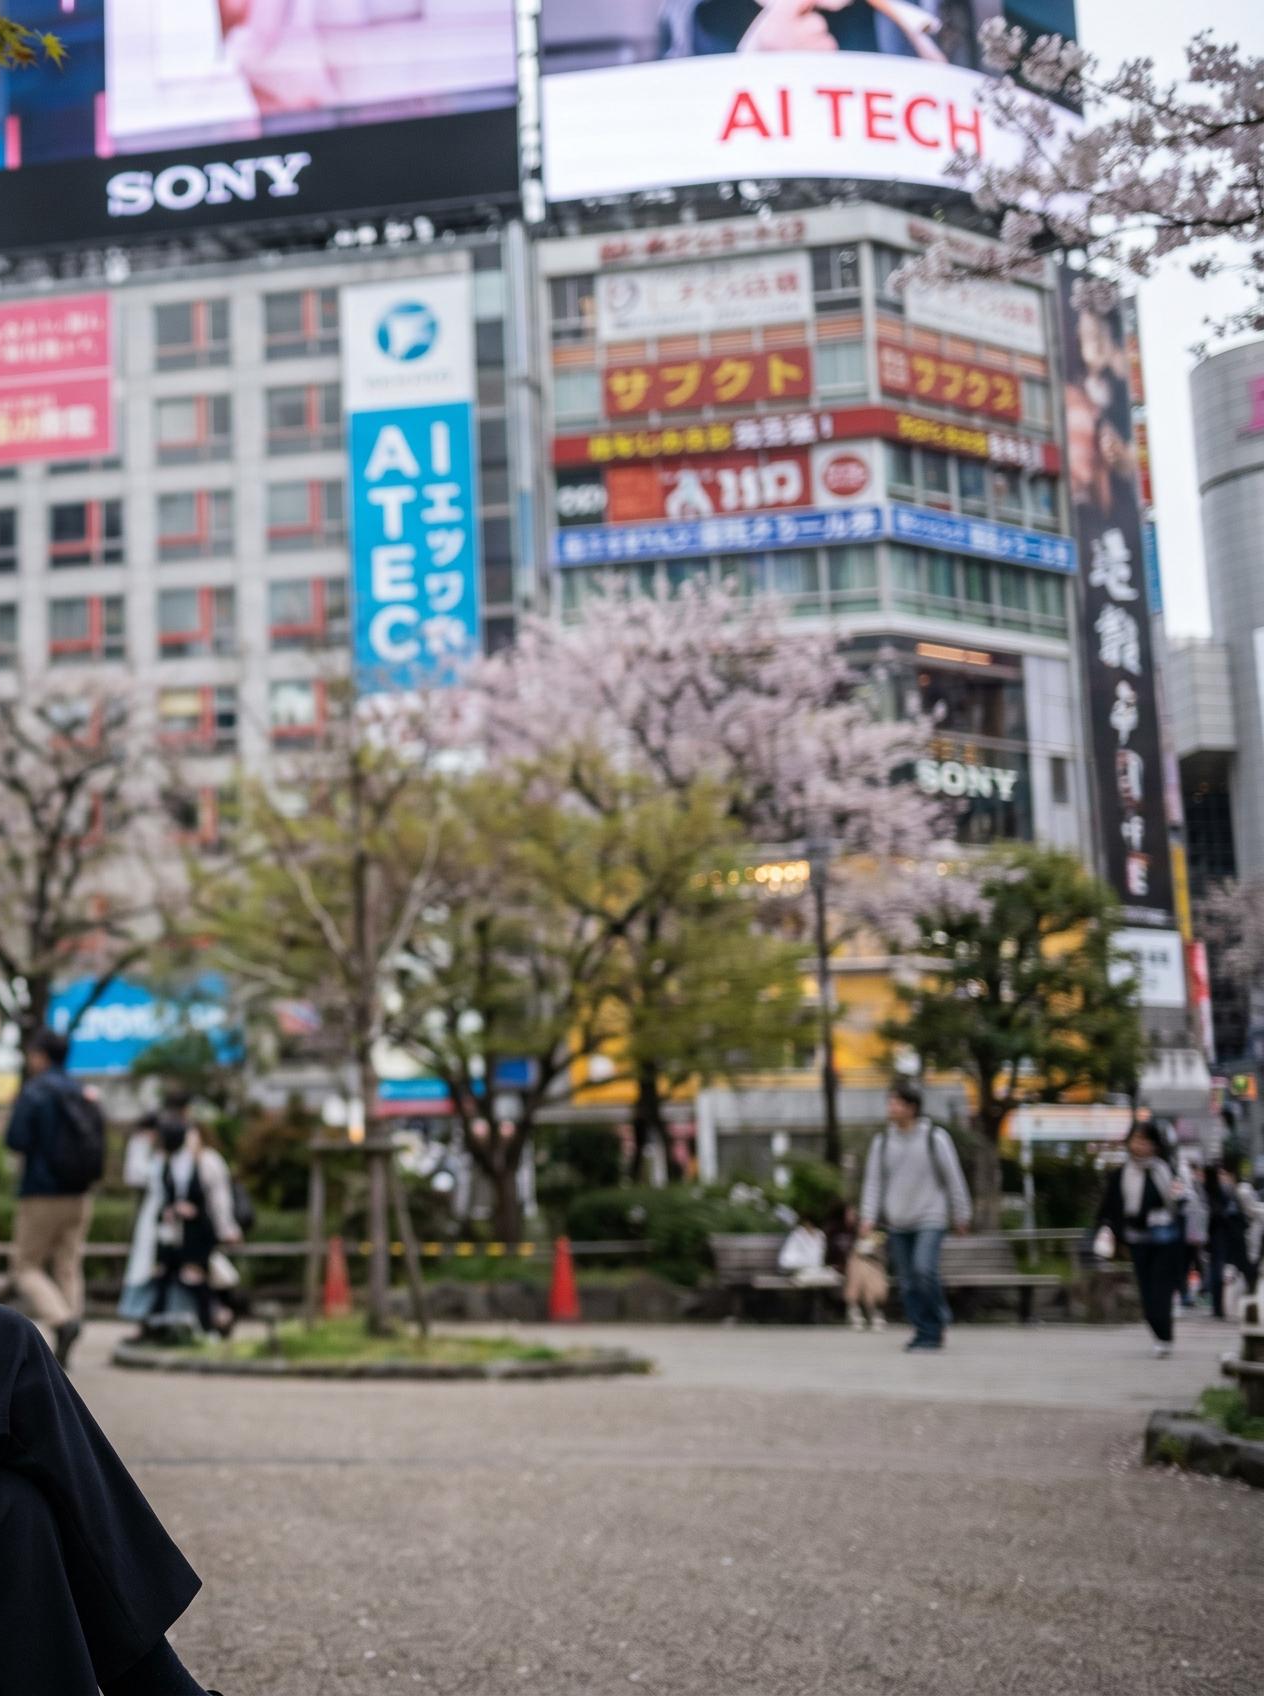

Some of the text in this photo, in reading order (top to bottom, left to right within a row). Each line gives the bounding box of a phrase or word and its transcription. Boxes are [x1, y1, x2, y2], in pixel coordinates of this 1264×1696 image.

[720, 89, 983, 158] AI TECH
[106, 152, 312, 217] SONY
[916, 759, 1018, 802] SONY
